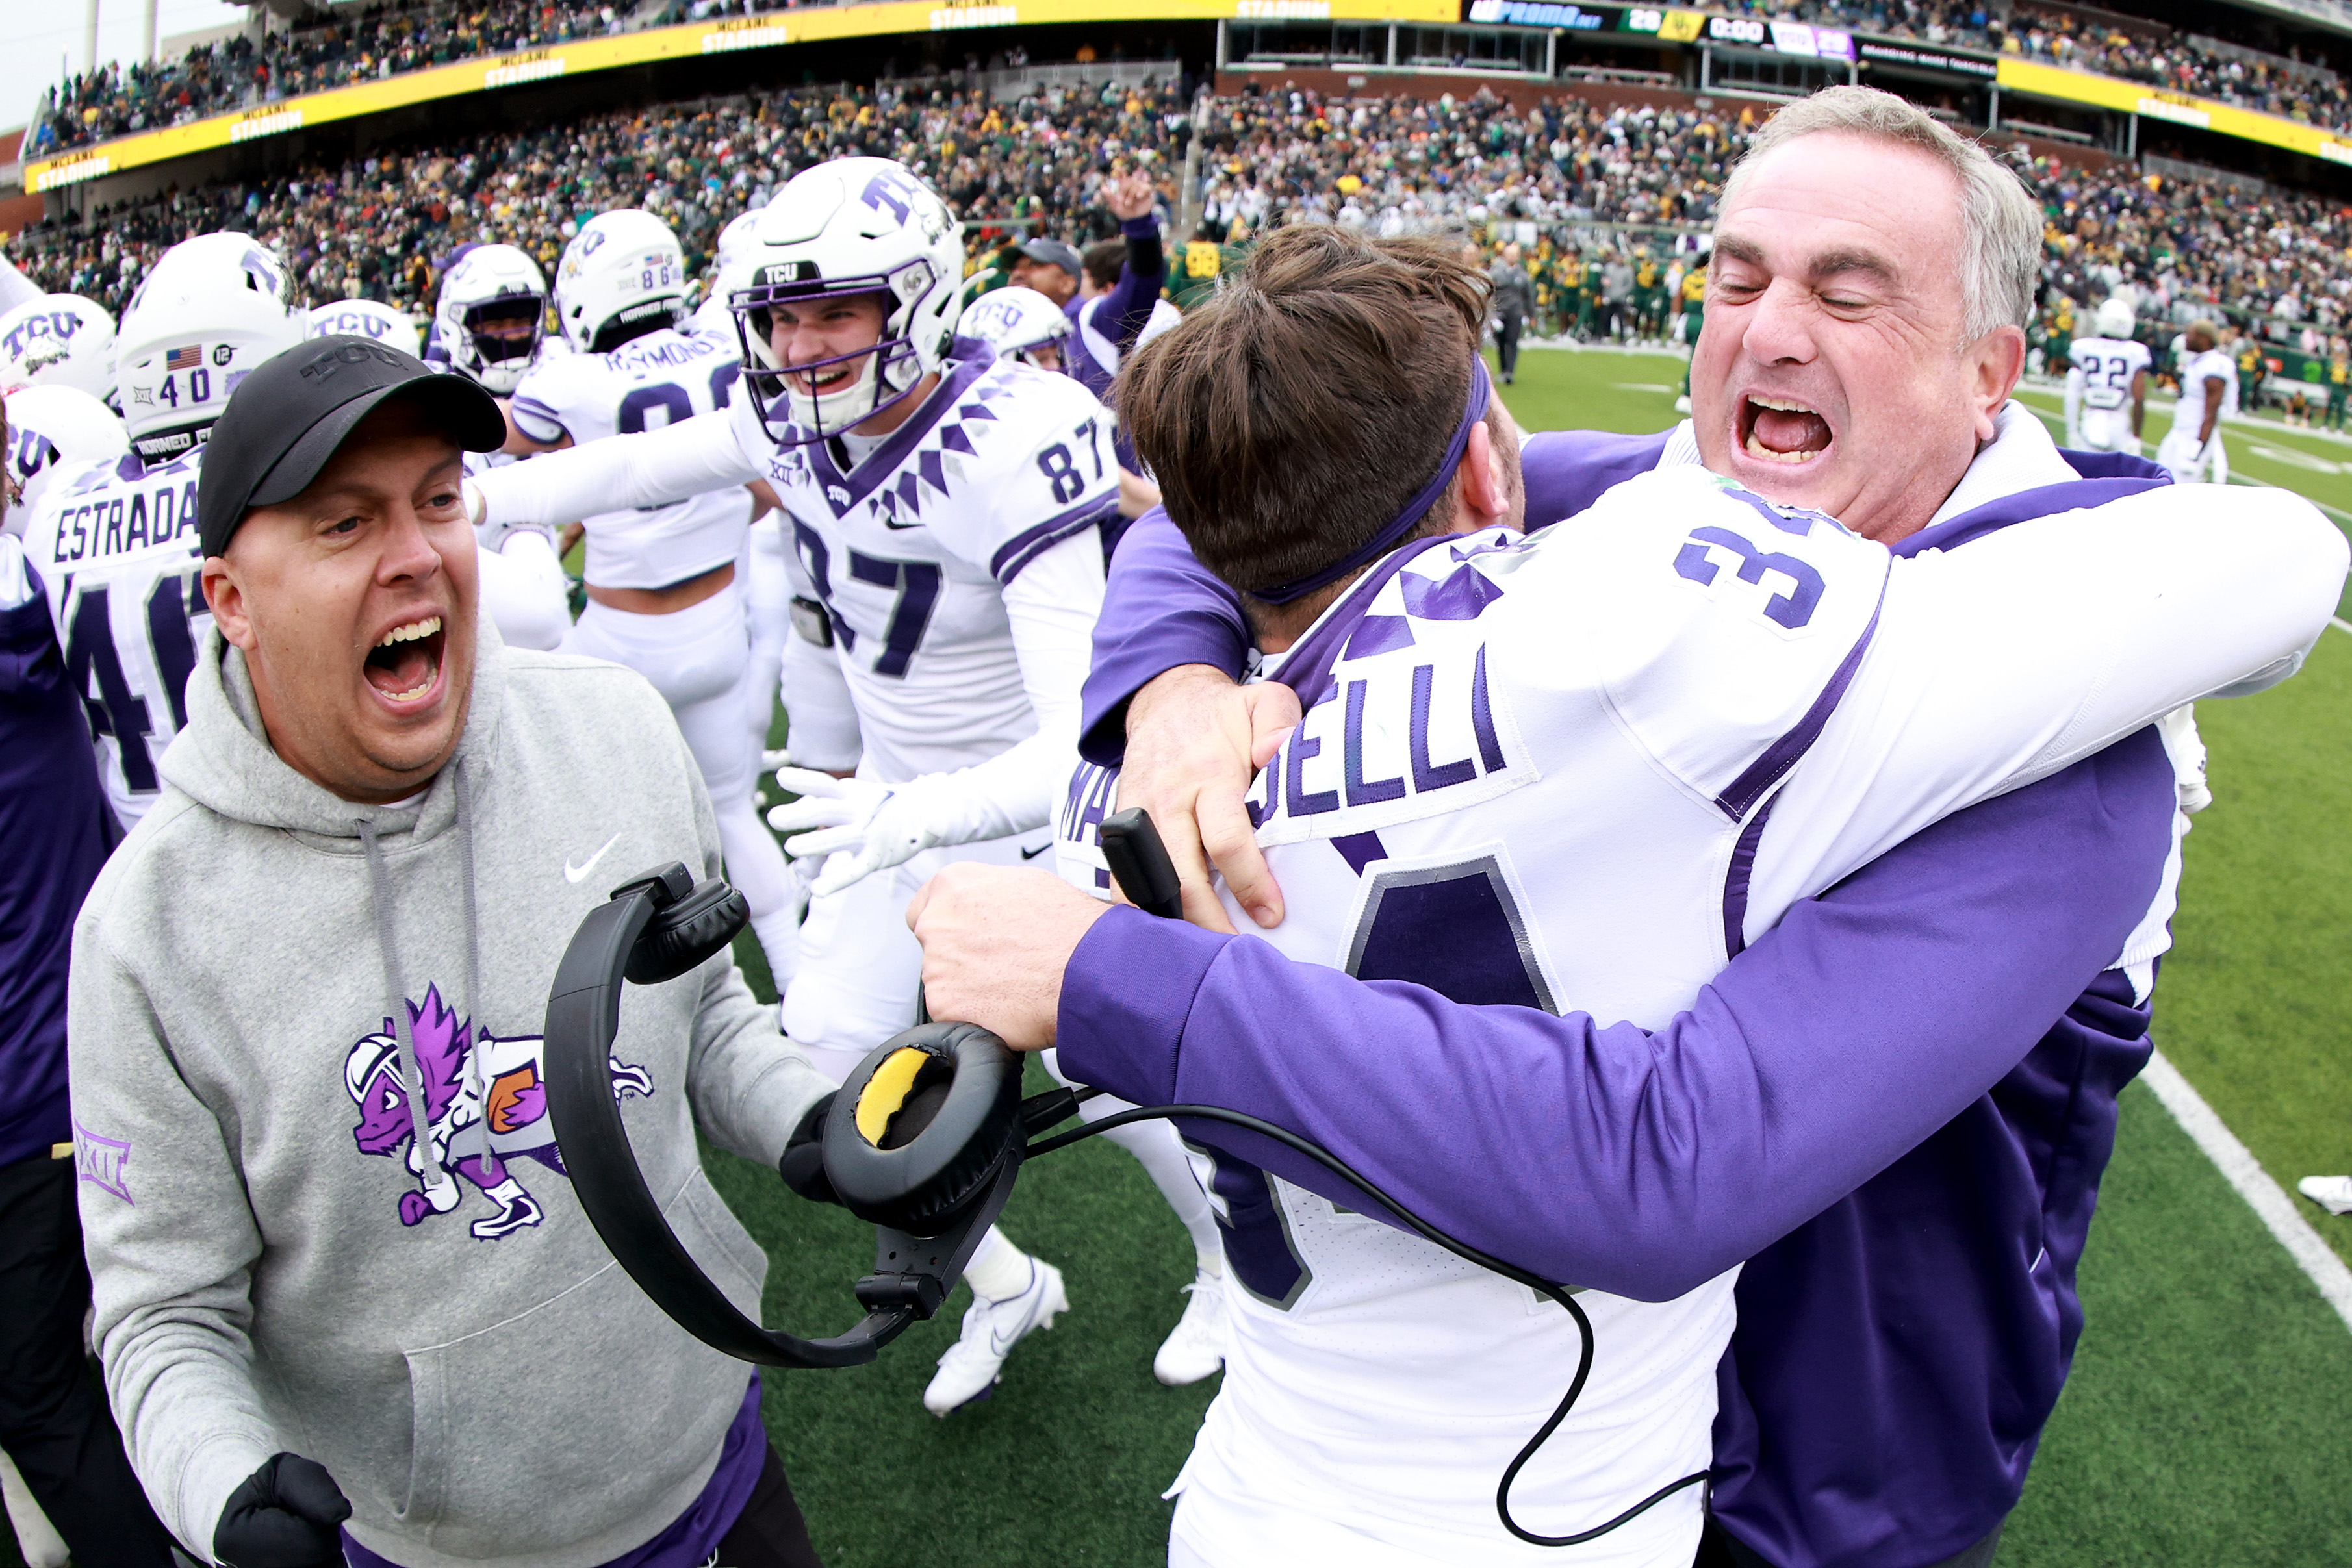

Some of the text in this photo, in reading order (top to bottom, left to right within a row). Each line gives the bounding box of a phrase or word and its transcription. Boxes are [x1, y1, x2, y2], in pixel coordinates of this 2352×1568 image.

[929, 5, 1017, 31] STADIUM
[1236, 0, 1331, 20] STADIUM
[1629, 9, 1662, 31] 28
[701, 25, 787, 55] STADIUM
[1709, 17, 1764, 43] 0:00
[485, 57, 565, 90] STADIUM
[229, 108, 302, 144] STADIUM
[37, 155, 109, 192] STADIUM
[764, 263, 799, 285] TCU
[3, 312, 77, 362] TCU
[314, 312, 385, 338] TCU
[160, 368, 211, 407] 40
[2084, 355, 2127, 390] 22
[137, 431, 192, 455] HORNED
[1036, 415, 1103, 505] 87
[827, 485, 852, 509] TCU
[54, 481, 200, 563] ESTRADA
